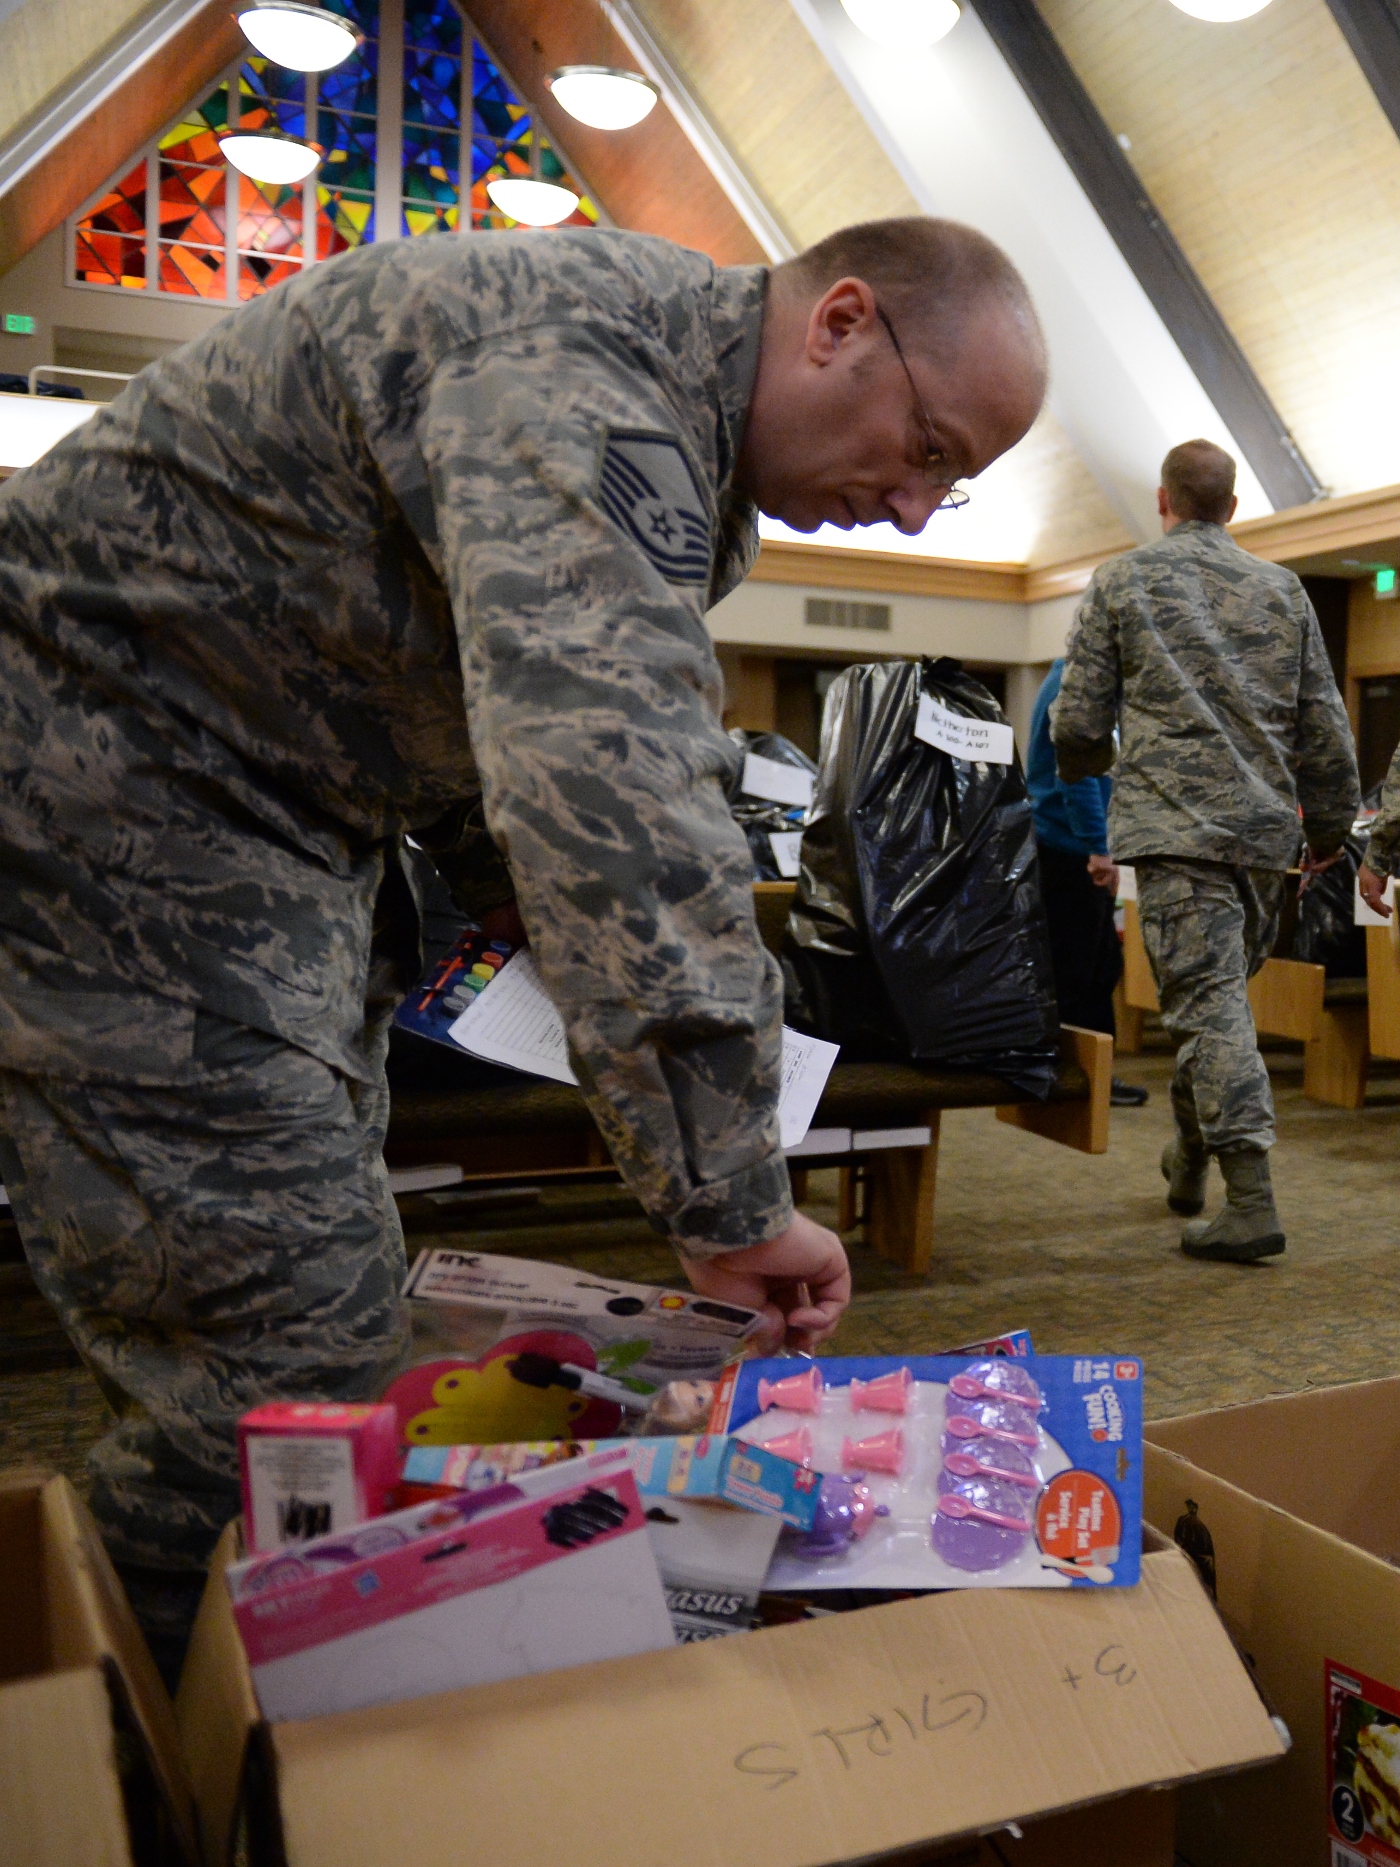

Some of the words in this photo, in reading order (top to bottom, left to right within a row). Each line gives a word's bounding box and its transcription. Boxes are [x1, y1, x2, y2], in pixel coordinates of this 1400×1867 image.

[1092, 1361, 1110, 1380] 14
[1082, 1391, 1107, 1430] FUN!
[1100, 1384, 1124, 1442] COOKING
[1058, 1490, 1073, 1530] Service
[1077, 1506, 1091, 1532] Play
[665, 1581, 744, 1616] asus
[733, 1688, 990, 1791] GIRLS
[1340, 1791, 1355, 1823] 2
